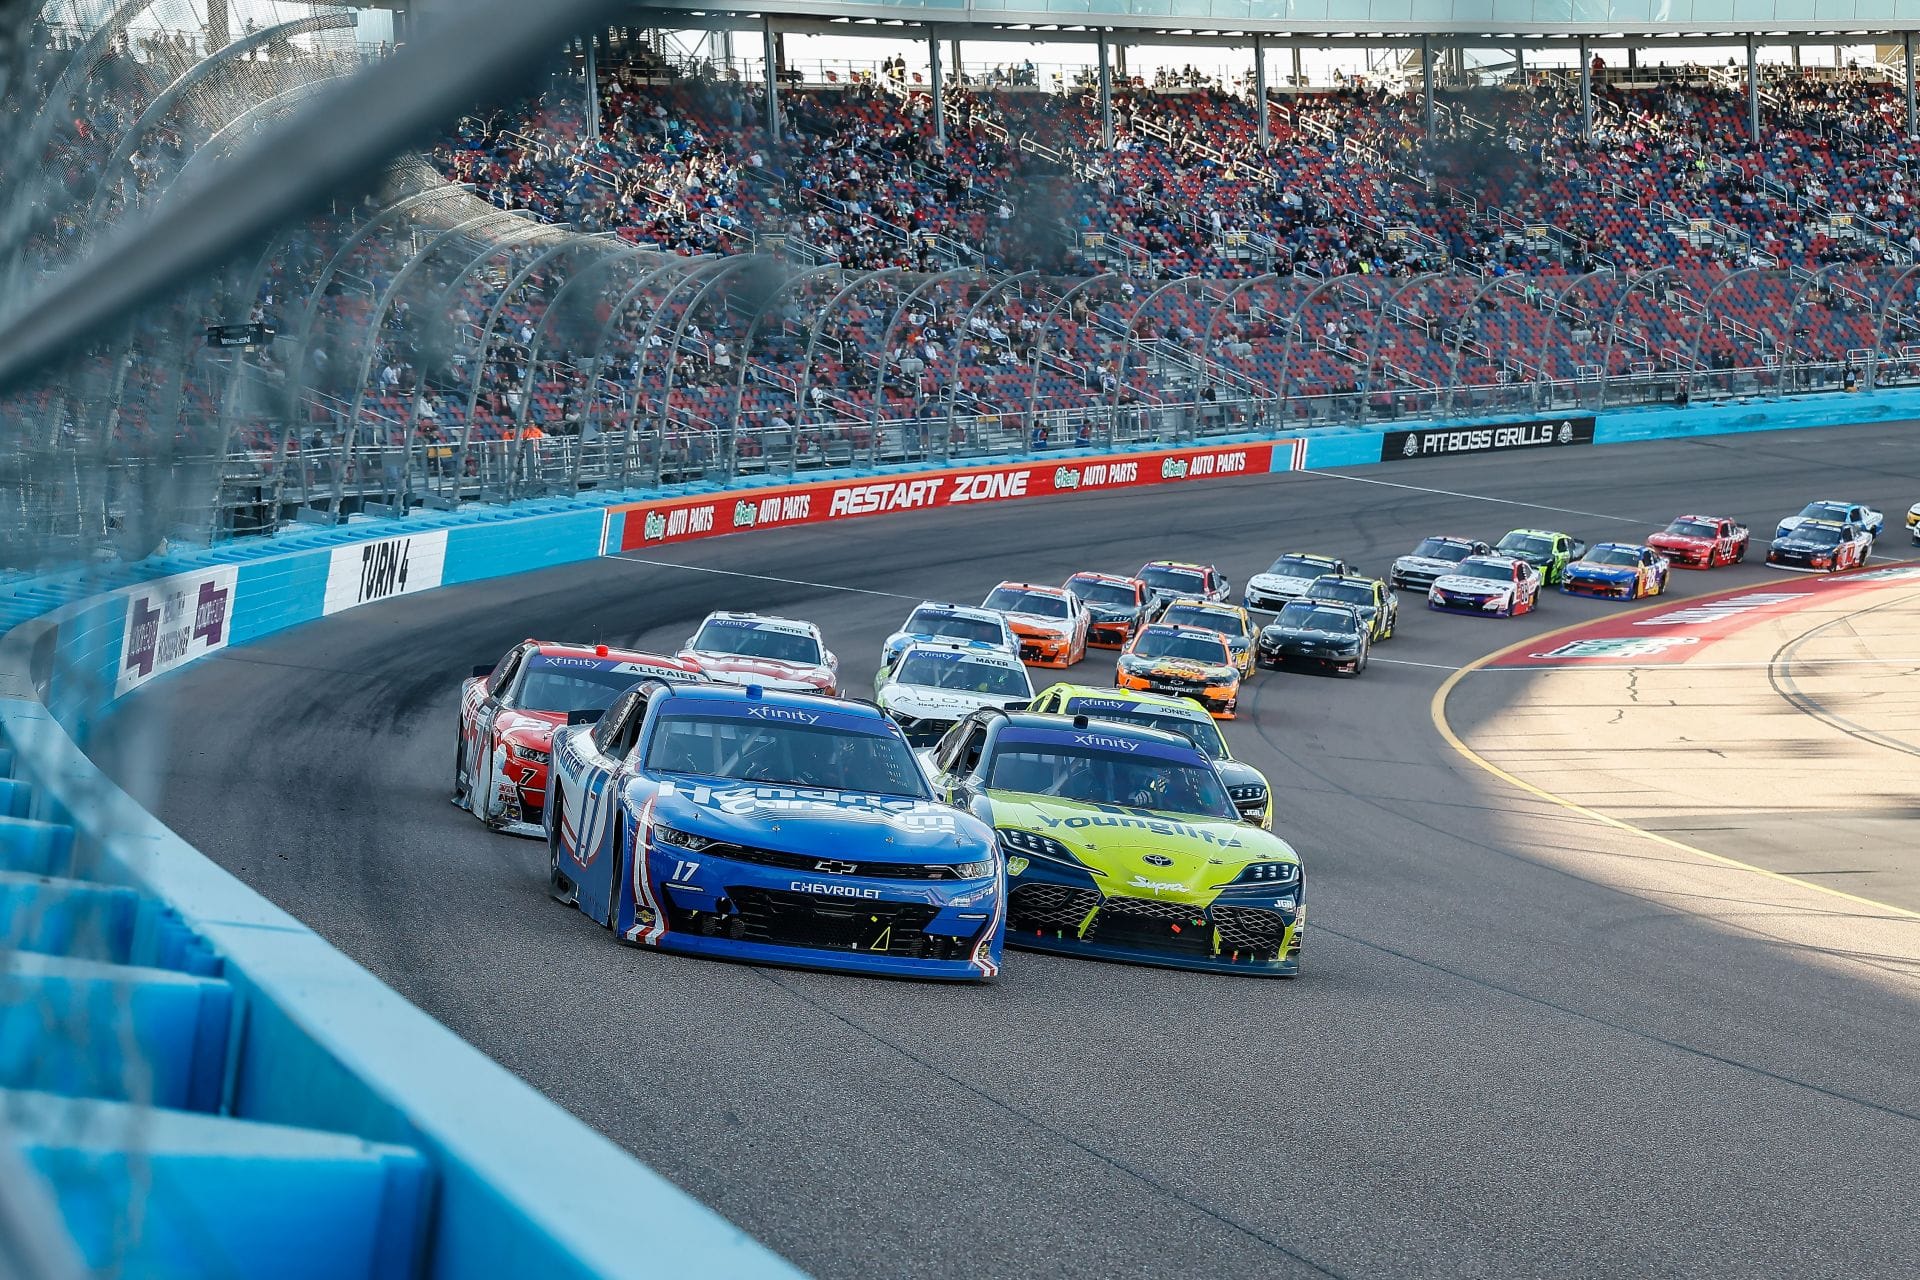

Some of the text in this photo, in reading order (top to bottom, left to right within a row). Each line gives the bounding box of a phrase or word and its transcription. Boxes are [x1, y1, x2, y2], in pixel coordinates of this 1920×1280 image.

[1422, 433, 1449, 453] PIT
[1493, 425, 1553, 448] GRILLS
[1082, 465, 1107, 486] AUTO
[1108, 462, 1138, 484] PARTS
[1189, 455, 1215, 477] AUTO
[1216, 452, 1246, 473] PARTS
[829, 470, 1030, 517] RESTART ZONE
[758, 498, 782, 524] AUTO
[781, 494, 811, 521] PARTS
[666, 508, 689, 537] AUTO
[687, 505, 715, 534] PARTS
[358, 538, 411, 603] TURN 4
[773, 626, 802, 635] SMITH
[544, 656, 602, 669] xfinity
[917, 651, 955, 660] xfinity
[975, 657, 1009, 668] MAYER
[628, 665, 698, 682] ALLGAIER
[1079, 698, 1126, 709] xfinity
[1159, 706, 1192, 717] JONES
[747, 706, 820, 725] xfinity
[1074, 733, 1140, 751] xfinity
[518, 768, 538, 786] 7
[1036, 812, 1244, 848] younglife
[671, 859, 701, 882] 17
[790, 880, 882, 900] CHEVROLET
[1127, 875, 1191, 897] Supra
